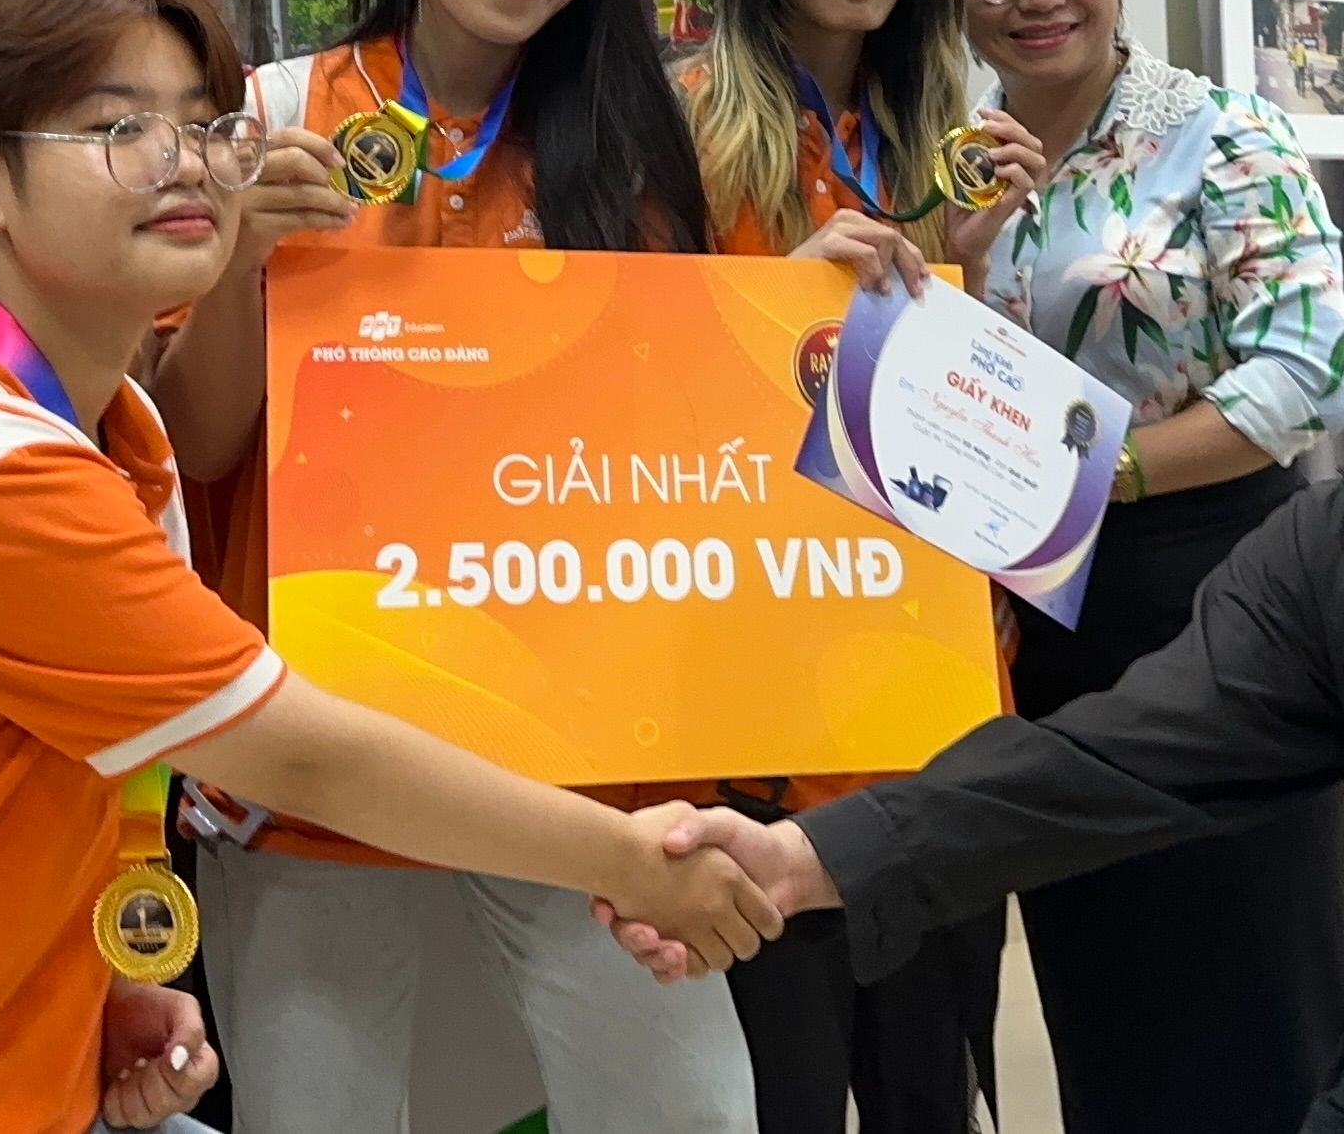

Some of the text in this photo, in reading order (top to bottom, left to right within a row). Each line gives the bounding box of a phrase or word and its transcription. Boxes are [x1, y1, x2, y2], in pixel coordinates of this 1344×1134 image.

[407, 345, 442, 363] CAO
[946, 370, 988, 403] GIẤY
[989, 394, 1033, 432] KHEN
[493, 435, 773, 506] GIẢI NHẤT
[375, 538, 736, 609] 2.500.000
[756, 538, 905, 599] VNĐ
